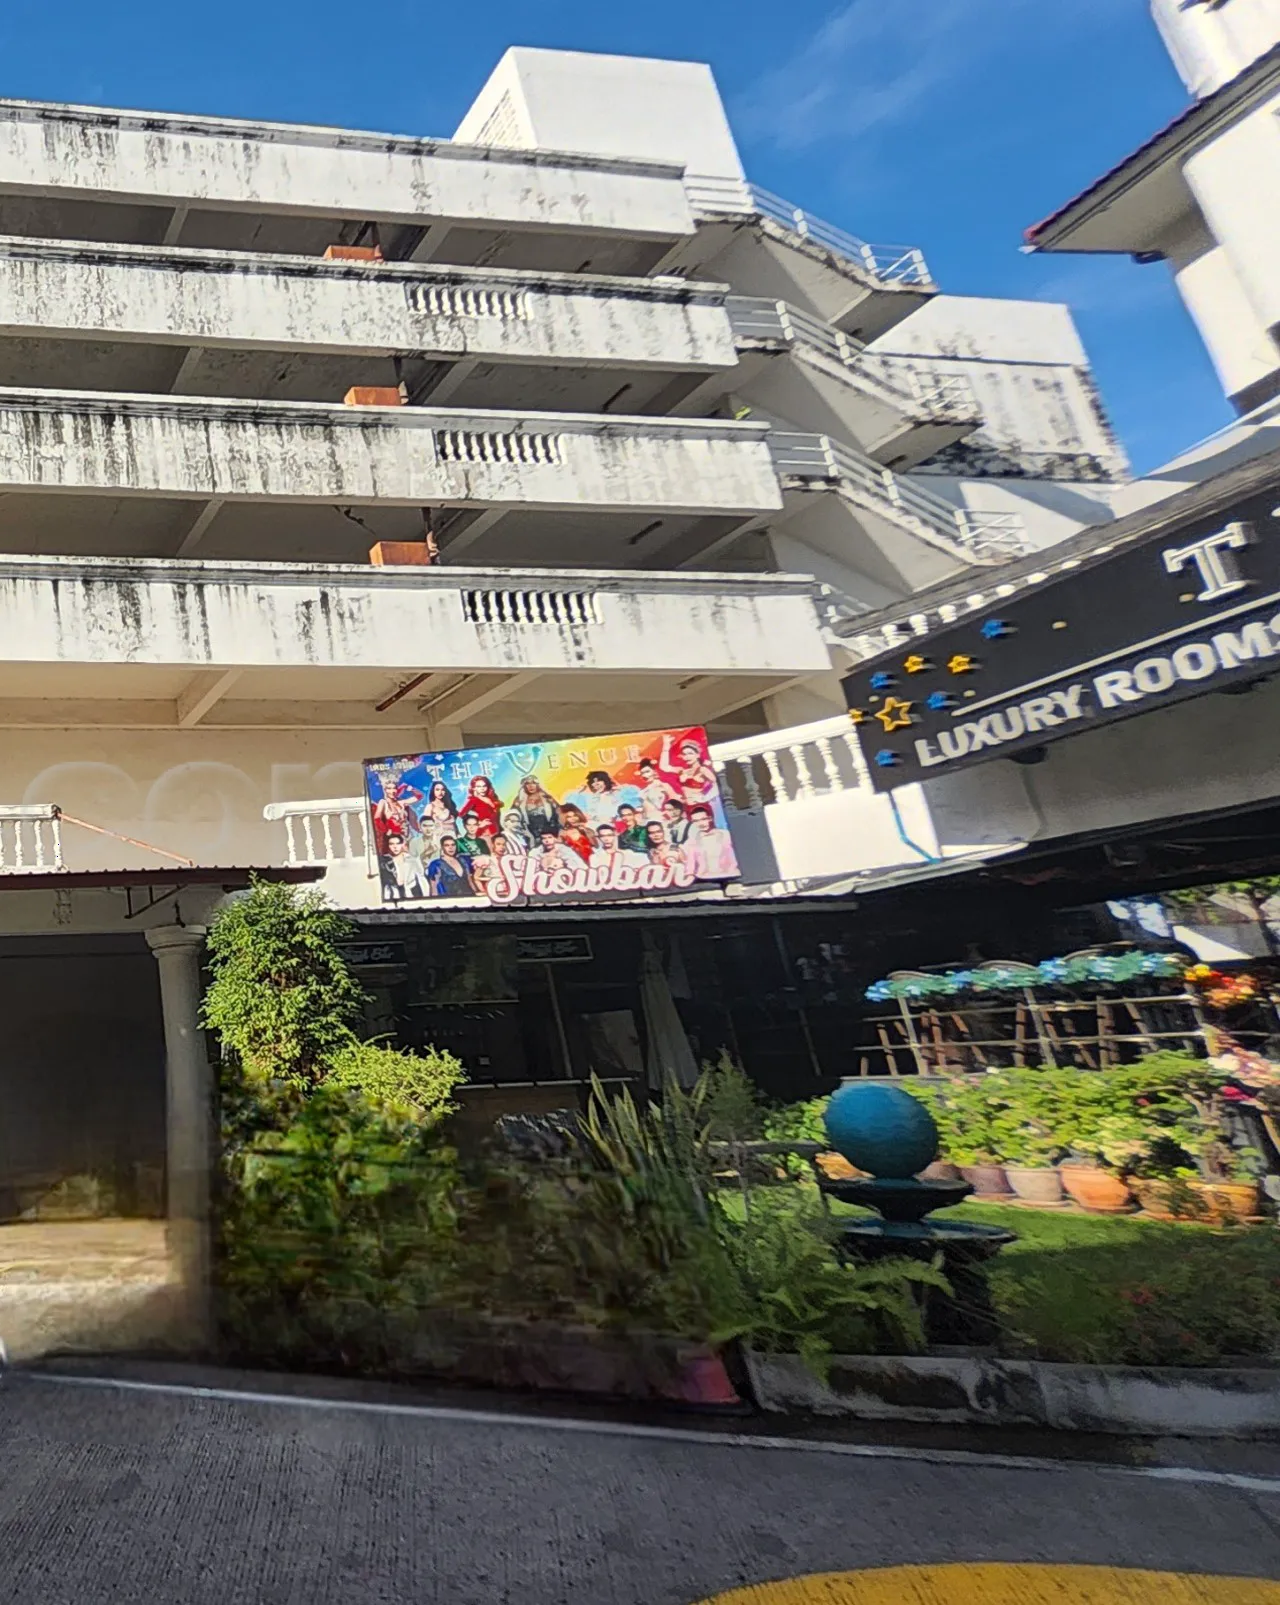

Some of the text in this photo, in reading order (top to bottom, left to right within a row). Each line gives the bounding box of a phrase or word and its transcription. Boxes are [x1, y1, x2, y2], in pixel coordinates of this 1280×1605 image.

[1162, 512, 1280, 601] T
[914, 612, 1280, 767] LUXURY ROOM
[426, 745, 642, 781] THE VENUE
[486, 850, 696, 904] Showbar
